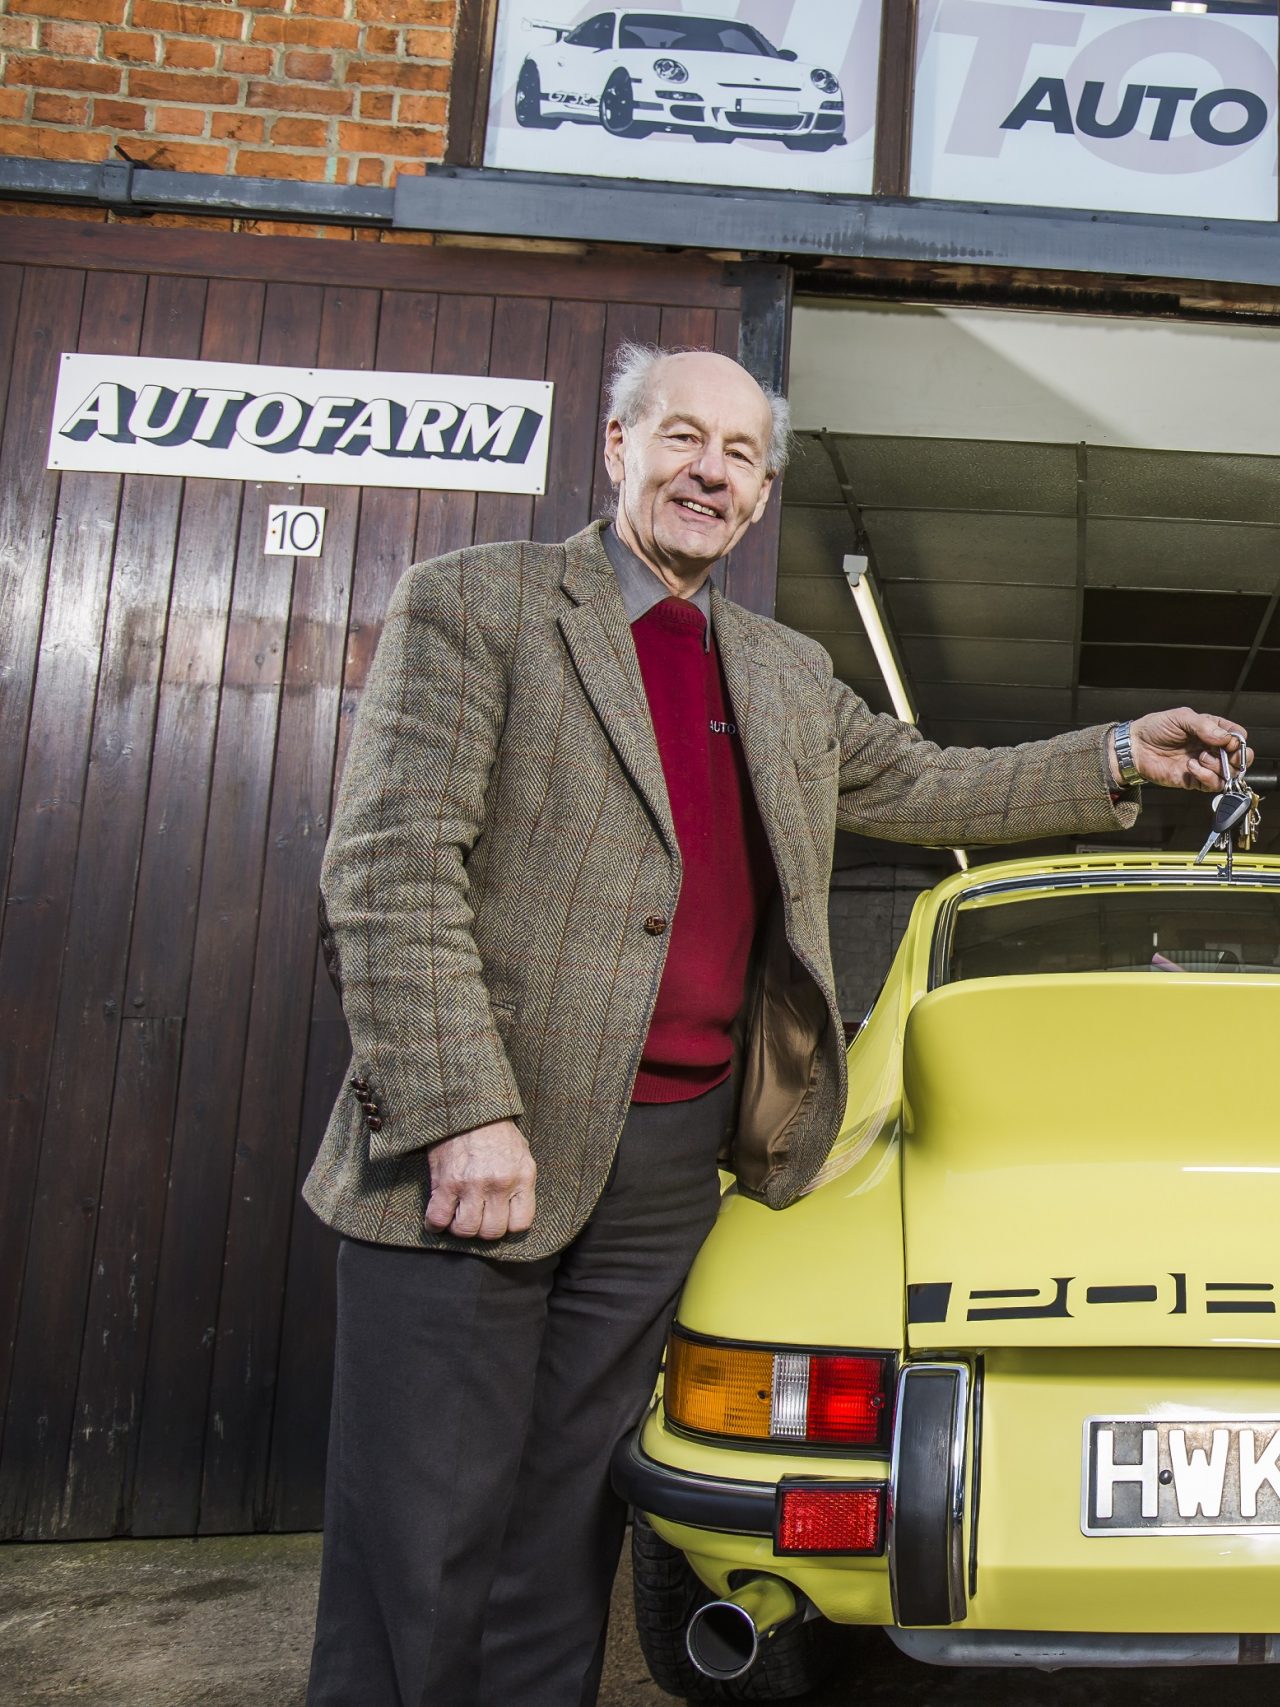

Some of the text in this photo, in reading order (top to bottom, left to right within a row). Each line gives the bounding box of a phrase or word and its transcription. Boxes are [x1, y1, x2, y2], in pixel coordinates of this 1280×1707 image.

[1000, 76, 1268, 146] AUTO
[58, 381, 544, 465] AUTOFARM
[271, 511, 320, 551] 10
